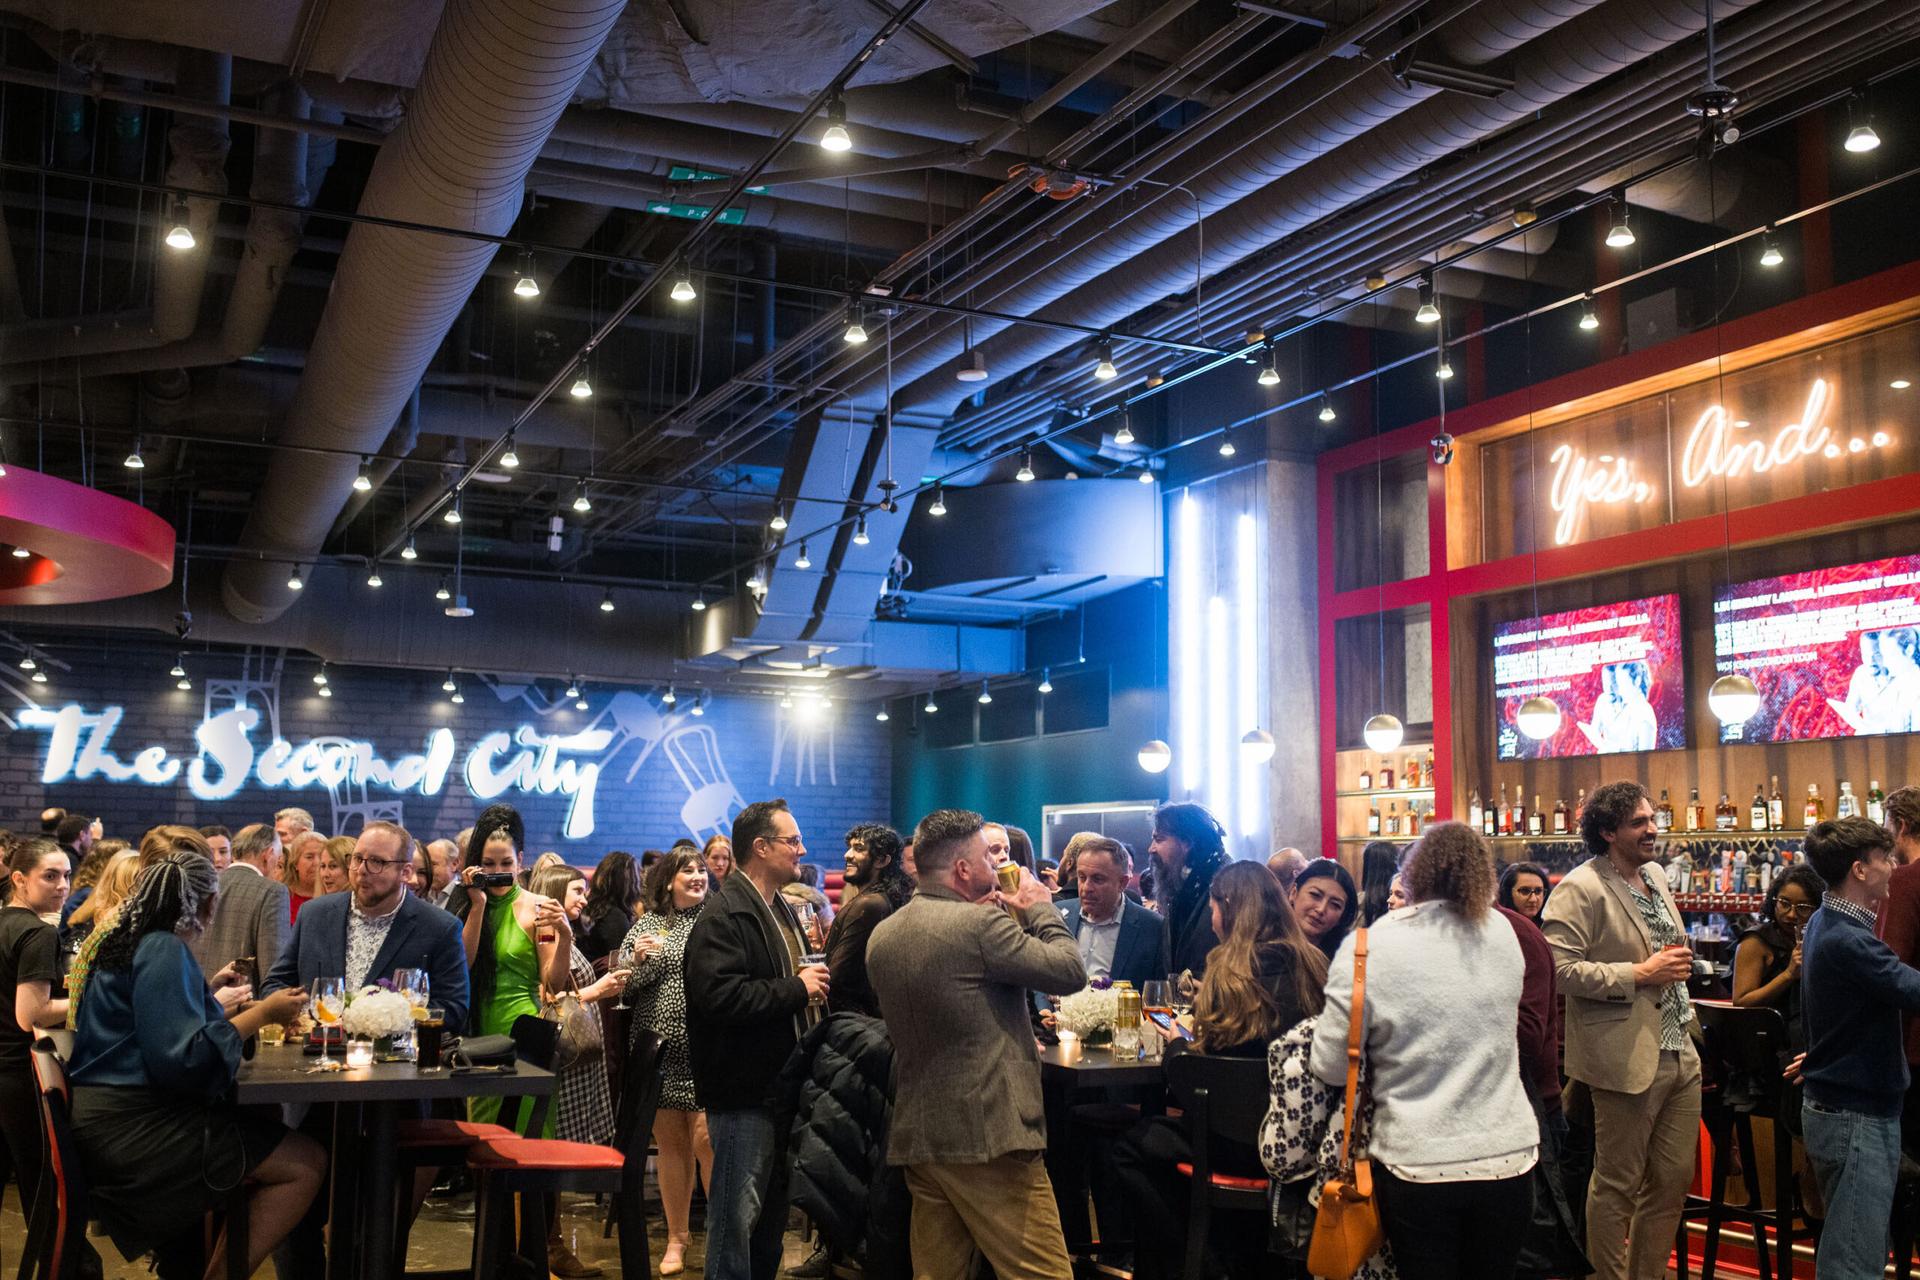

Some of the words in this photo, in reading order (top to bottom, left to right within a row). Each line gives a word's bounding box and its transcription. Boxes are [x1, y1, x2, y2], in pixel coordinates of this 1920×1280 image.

[1550, 444, 1649, 545] Yes,
[18, 705, 180, 784] The
[188, 707, 456, 798] Second
[465, 725, 613, 839] City
